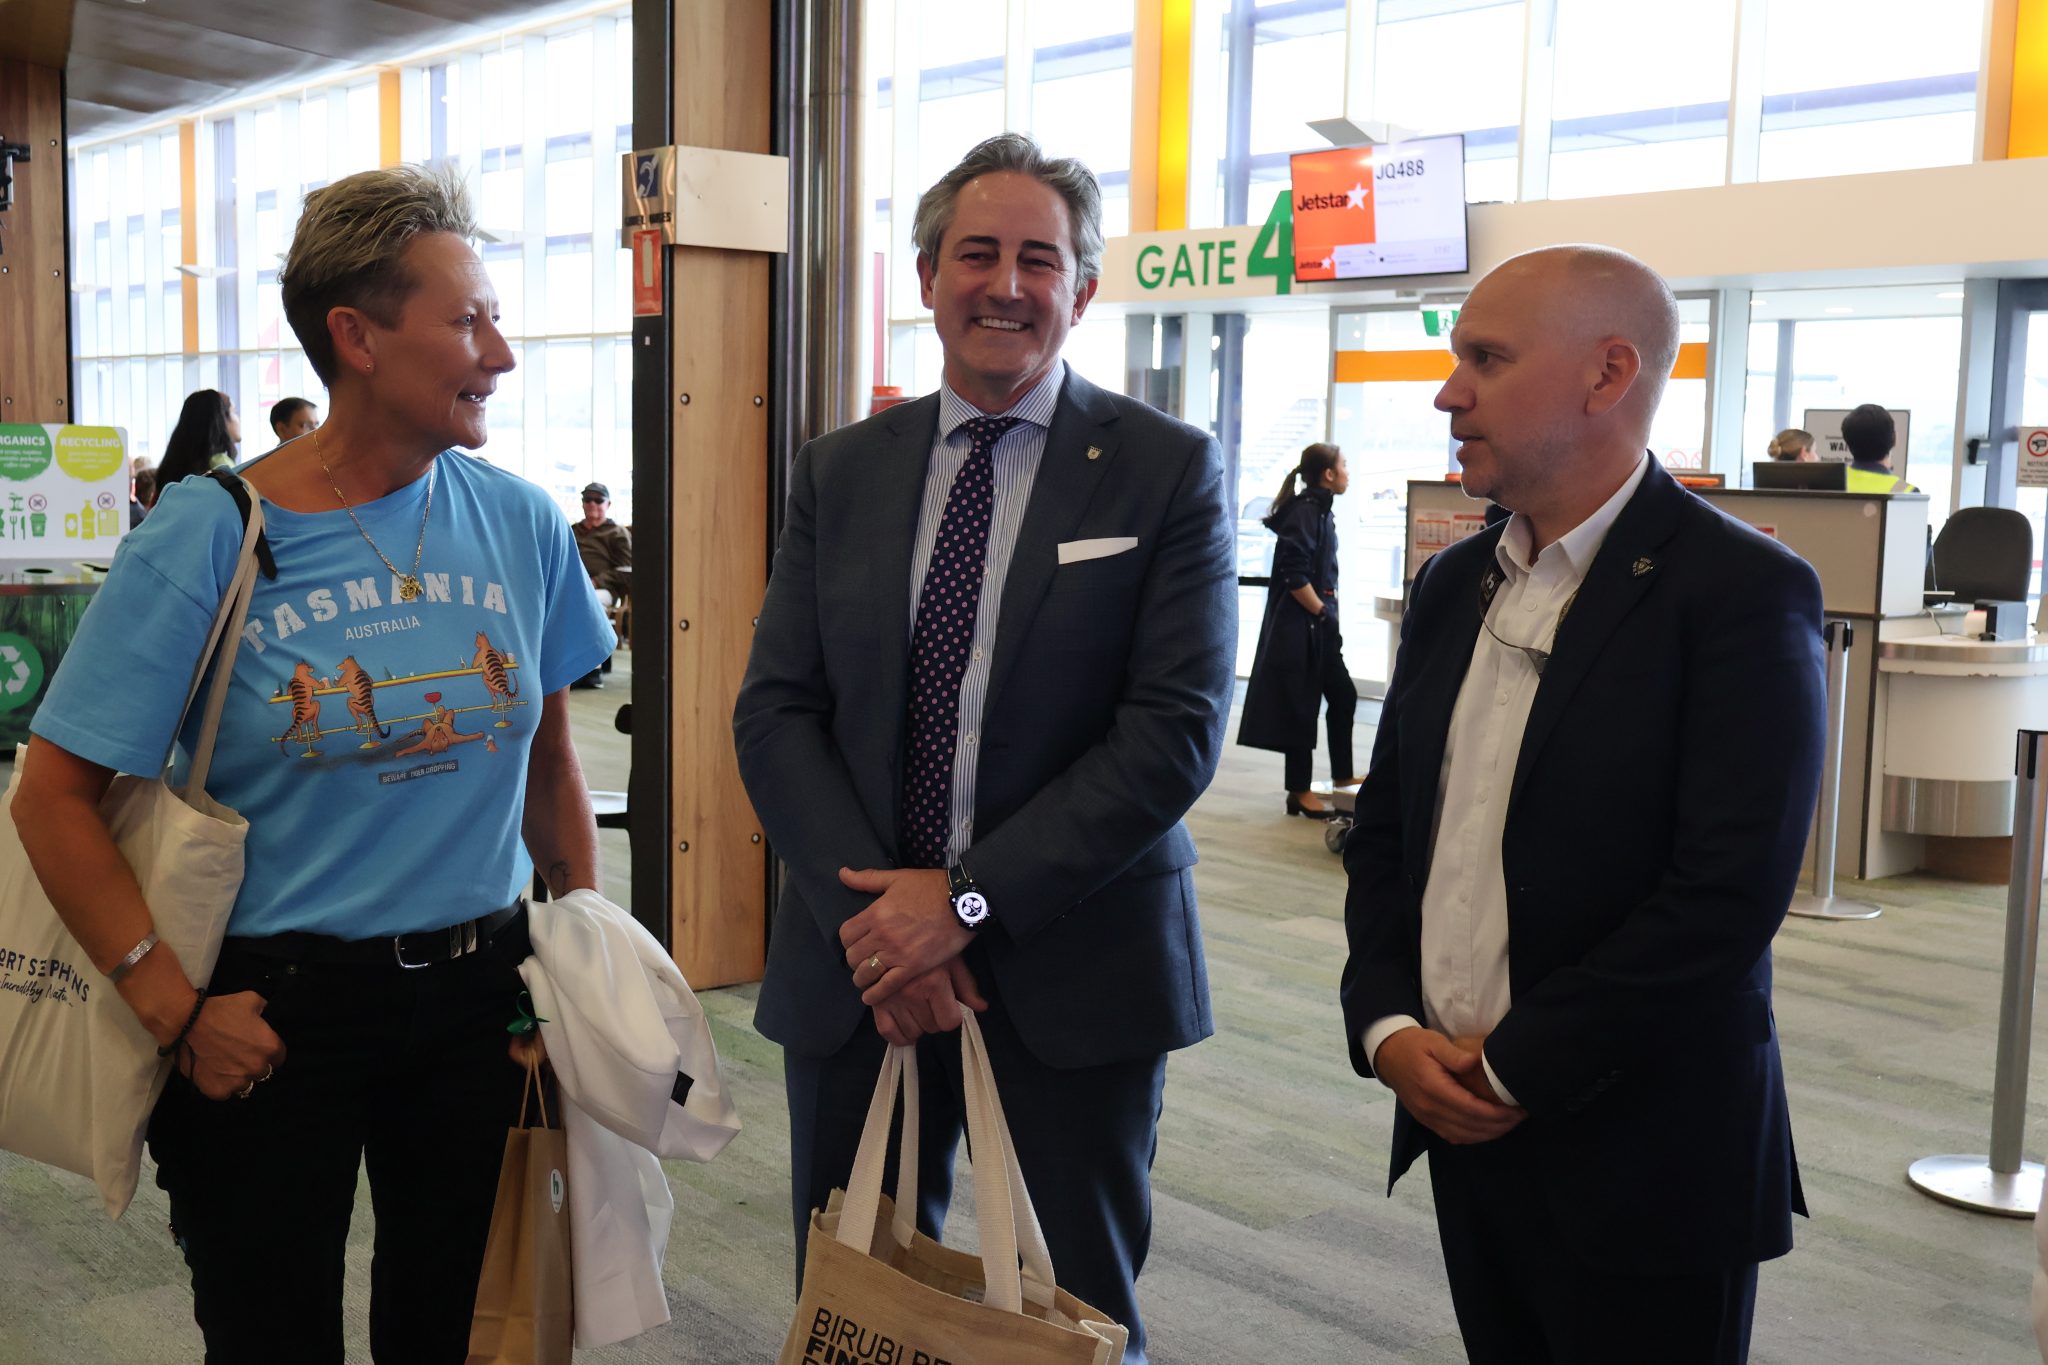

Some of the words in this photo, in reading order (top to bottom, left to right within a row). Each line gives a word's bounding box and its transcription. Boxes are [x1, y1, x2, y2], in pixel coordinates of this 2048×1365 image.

[1376, 159, 1425, 180] JQ488
[1297, 192, 1349, 212] Jetstar
[1136, 240, 1237, 289] GATE
[1246, 190, 1295, 295] 4
[60, 437, 121, 448] RECYCLING
[241, 572, 507, 654] TASMANIA
[345, 615, 421, 641] AUSTRALIA
[811, 1307, 904, 1365] BIRUBI
